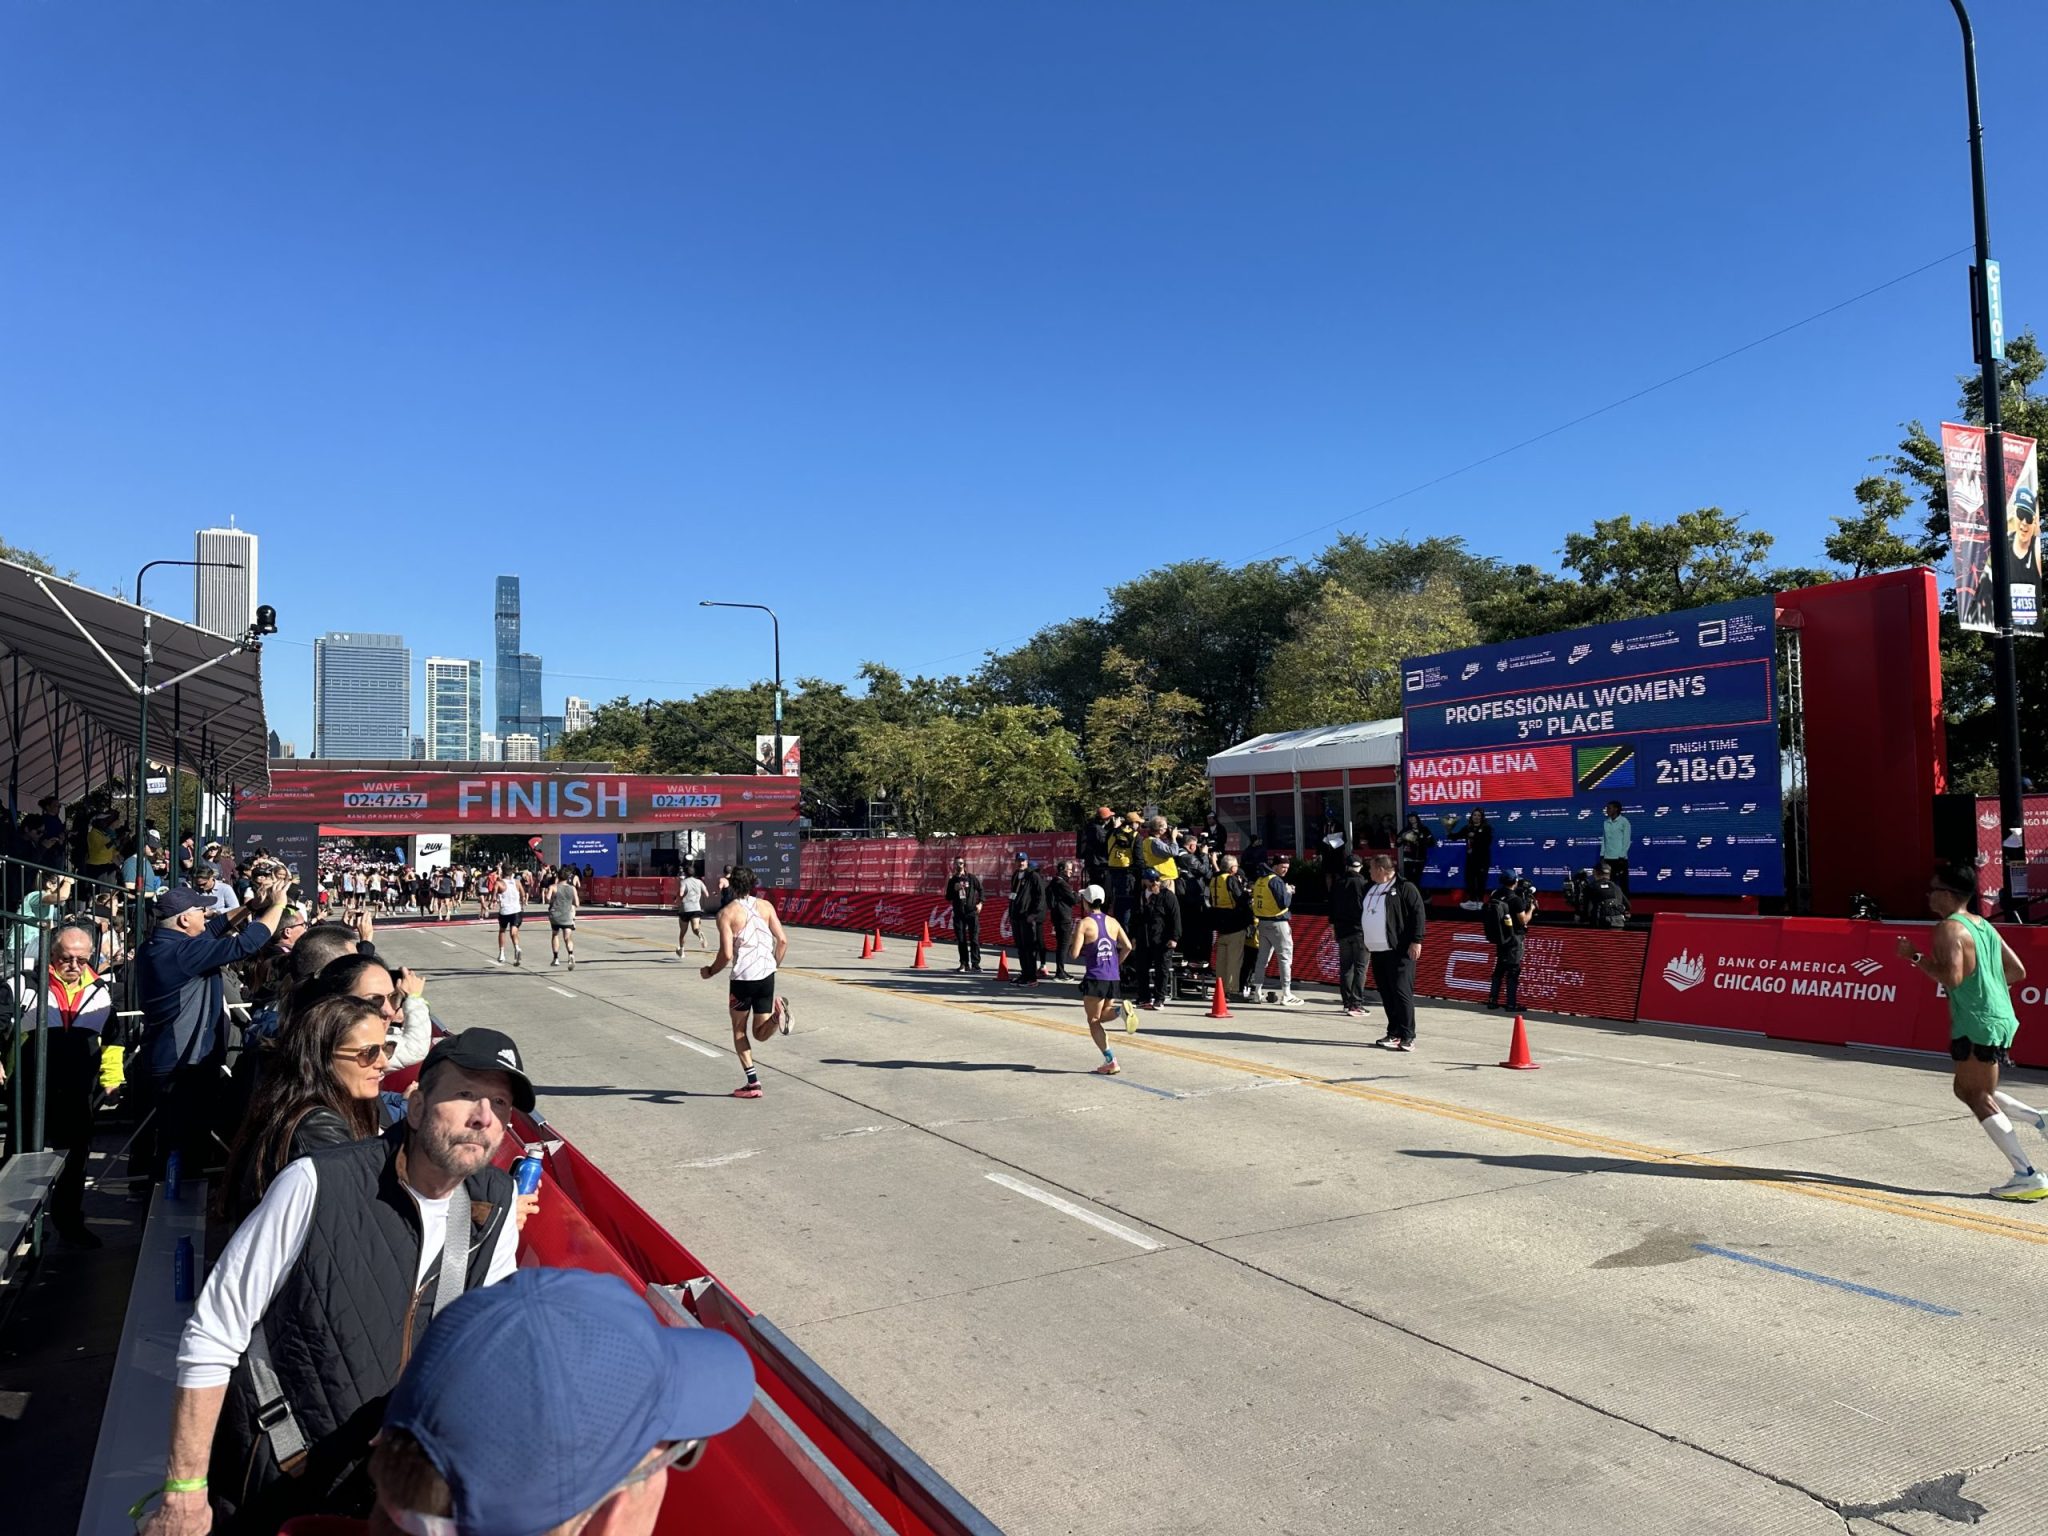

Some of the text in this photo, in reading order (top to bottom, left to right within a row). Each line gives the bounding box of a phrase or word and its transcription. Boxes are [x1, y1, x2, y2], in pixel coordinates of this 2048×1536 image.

[1445, 675, 1706, 724] PROFESSIONAL WOMEN'S
[1548, 711, 1614, 736] PLACE
[1670, 738, 1739, 754] FINISH TIME
[1409, 753, 1538, 778] MAGDALENA
[1656, 755, 1756, 783] 2:18:03
[363, 783, 400, 791] WAVE
[667, 785, 699, 793] WAVE
[1409, 780, 1480, 801] SHAURI
[349, 794, 422, 806] 02:47:57
[458, 781, 627, 817] FINISH
[656, 795, 717, 806] 02:47:57
[424, 843, 443, 851] RUN
[1718, 956, 1846, 974] BANK OF AMERICA
[1519, 967, 1585, 986] ARATHON
[1714, 973, 1897, 1002] CHICAGO MARATHON
